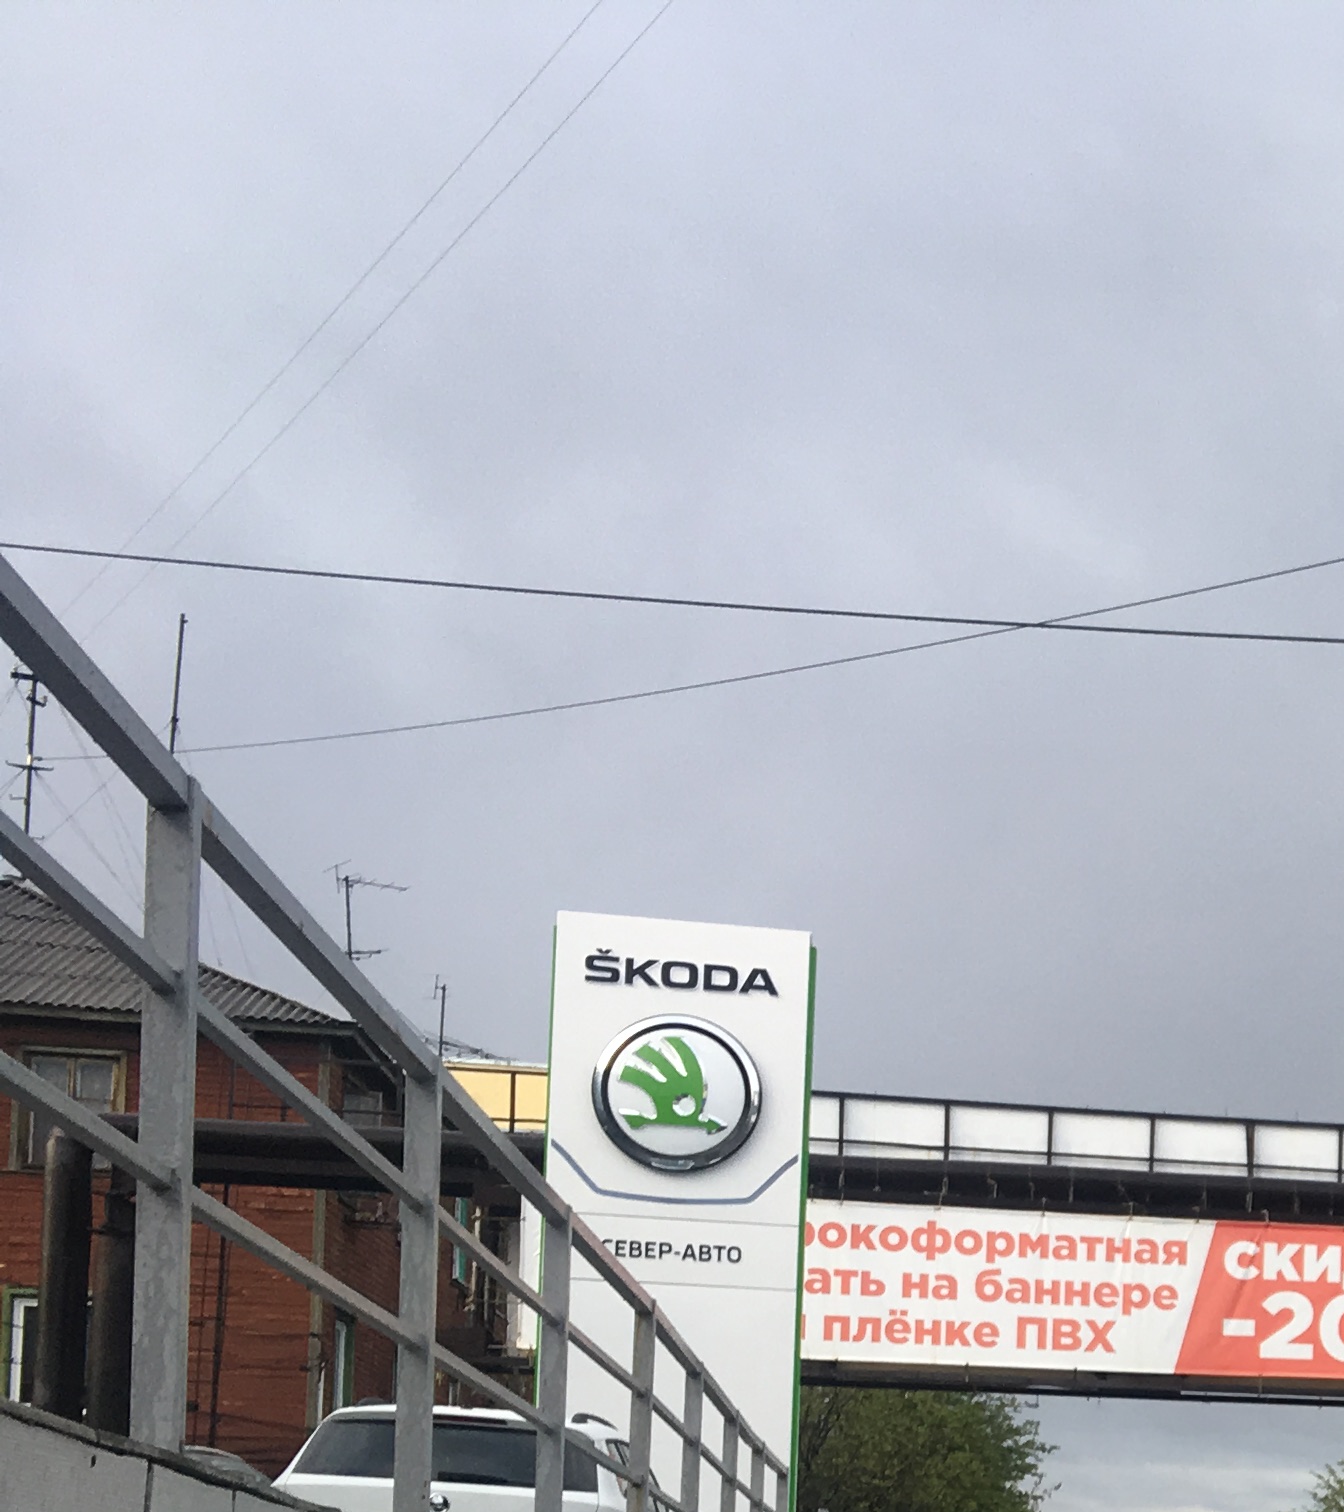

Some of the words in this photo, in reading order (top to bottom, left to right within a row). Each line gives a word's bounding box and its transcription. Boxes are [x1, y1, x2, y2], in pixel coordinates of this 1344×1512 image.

[585, 948, 779, 997] ŠKODA
[902, 1272, 958, 1300] на
[975, 1269, 1178, 1316] баннере
[823, 1309, 999, 1348] плёнке
[1016, 1316, 1116, 1353] ПВХ
